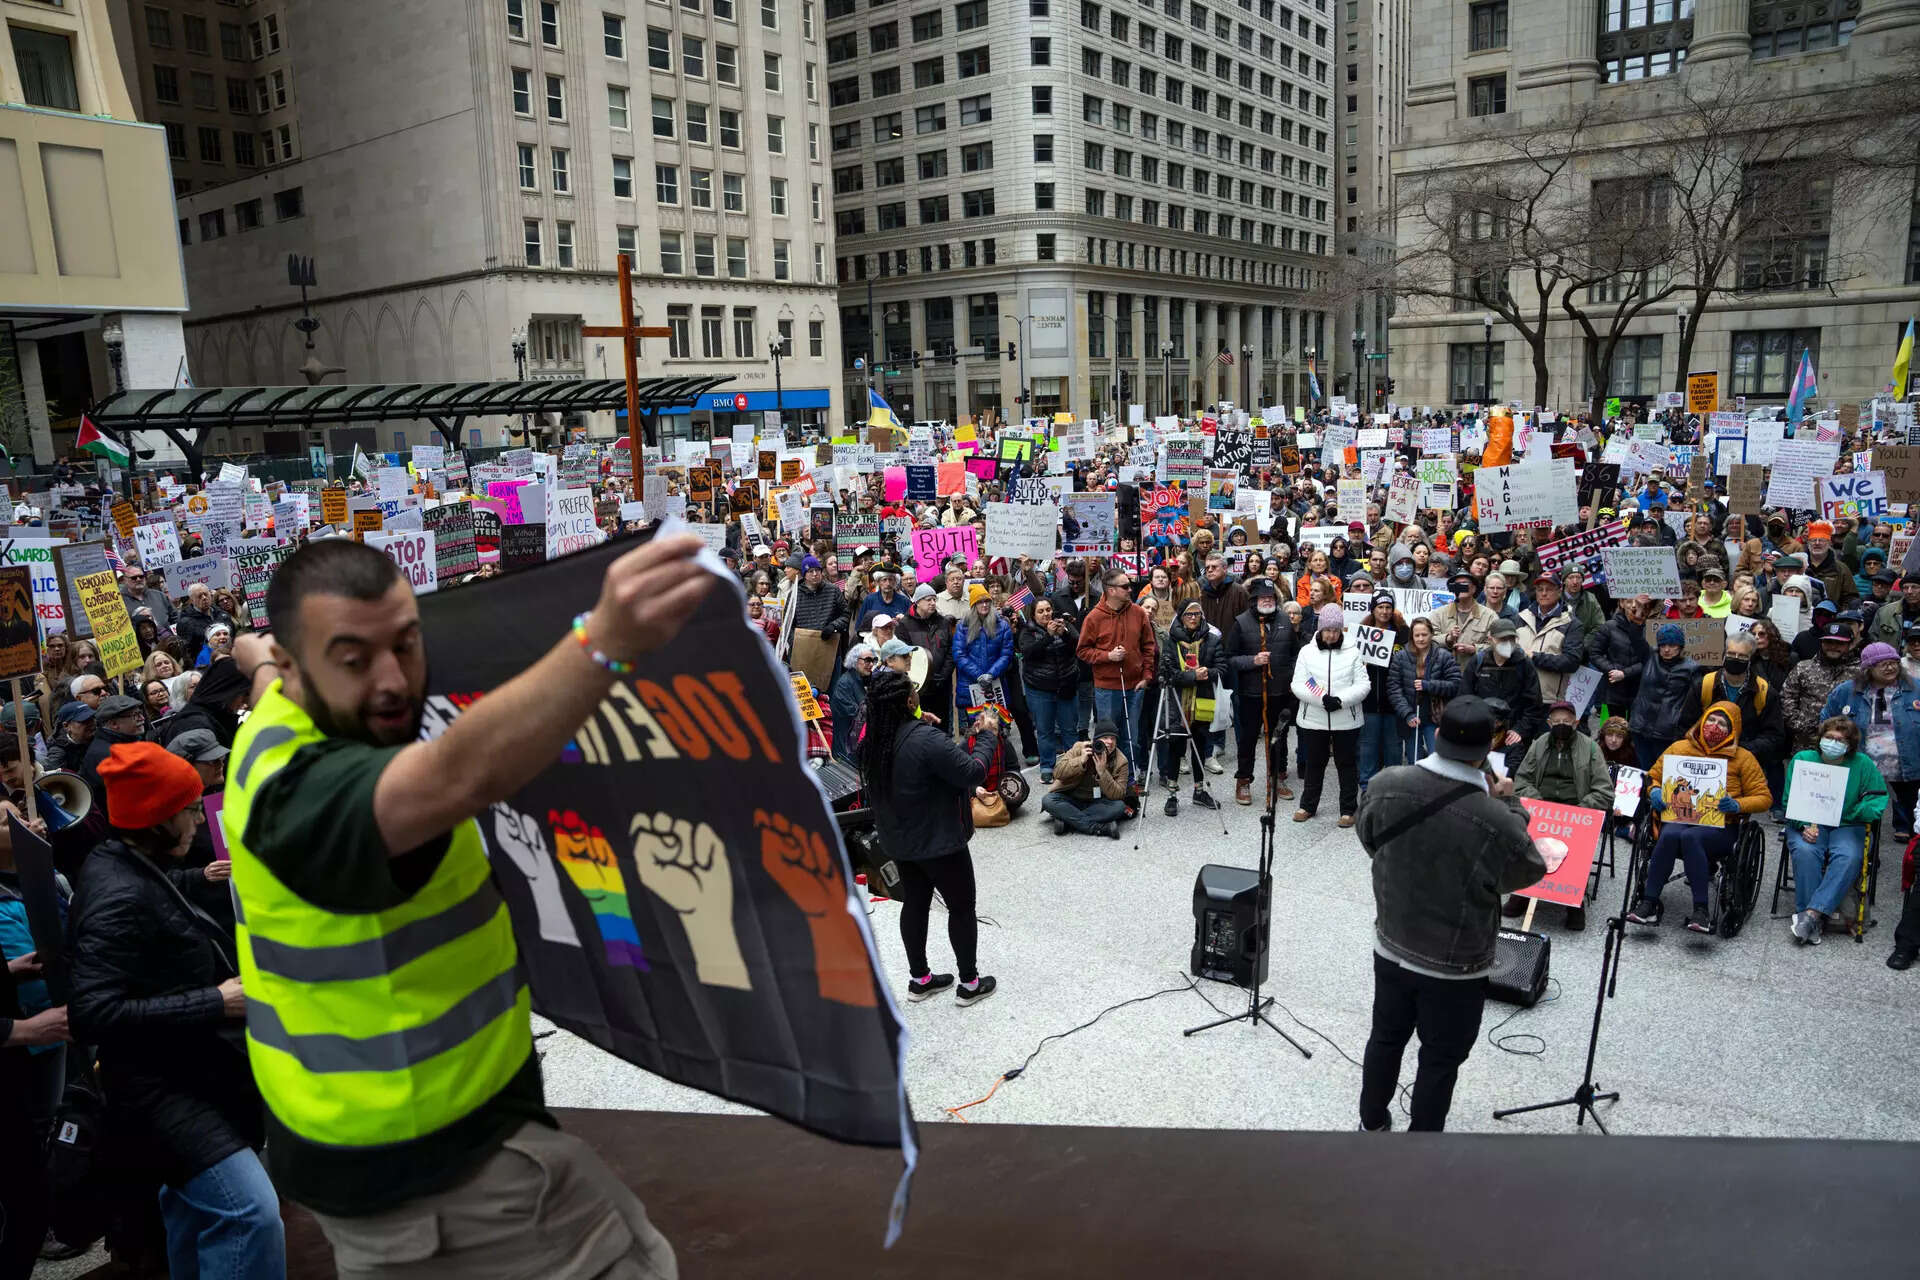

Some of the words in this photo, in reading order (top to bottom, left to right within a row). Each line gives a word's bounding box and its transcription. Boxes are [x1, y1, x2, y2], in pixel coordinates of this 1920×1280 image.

[713, 396, 734, 408] BMO
[1168, 441, 1187, 449] STOP
[1190, 441, 1203, 449] THE
[1217, 431, 1233, 444] WE
[1236, 433, 1253, 445] ARE
[833, 446, 857, 455] HANDS
[1214, 445, 1252, 469] NATION
[1232, 462, 1248, 471] OF
[1424, 460, 1448, 472] DUE
[1584, 463, 1611, 481] 86
[1015, 478, 1046, 490] NAZIS
[1416, 471, 1456, 484] PROCESS
[1014, 488, 1036, 499] OUT
[1038, 488, 1050, 499] OF
[1829, 478, 1874, 498] We
[558, 495, 594, 516] PREFER
[1149, 488, 1184, 508] JOY
[424, 507, 446, 523] STOP
[451, 502, 471, 515] THE
[1823, 497, 1888, 520] PEOPLE
[205, 522, 225, 530] THEY
[474, 520, 497, 528] OICE
[571, 518, 594, 534] ICE
[837, 514, 859, 525] STOP
[863, 514, 877, 524] THE
[1504, 519, 1553, 532] TRAITORS
[474, 528, 501, 536] TTERS
[1149, 522, 1183, 536] FEAR
[209, 537, 226, 546] FOR
[518, 535, 546, 545] PROCES
[557, 534, 597, 555] CRUSHED
[919, 530, 975, 553] RUTH
[0, 538, 54, 566] KOWARDI
[229, 545, 245, 556] NO
[246, 544, 277, 554] KINGS
[384, 537, 426, 565] STOP
[1545, 550, 1579, 570] OFF
[1583, 537, 1621, 558] OUR
[176, 560, 218, 575] Community
[240, 552, 270, 569] STOP
[1112, 555, 1147, 571] NAZS
[241, 565, 265, 575] TRUMP
[77, 572, 113, 590] DEMOCRATS
[1344, 601, 1372, 611] RES
[1403, 589, 1432, 614] KINGS
[1356, 626, 1385, 643] NO
[1527, 804, 1594, 826] KILLING
[1536, 821, 1574, 838] OUR
[1536, 880, 1582, 897] CRACY
